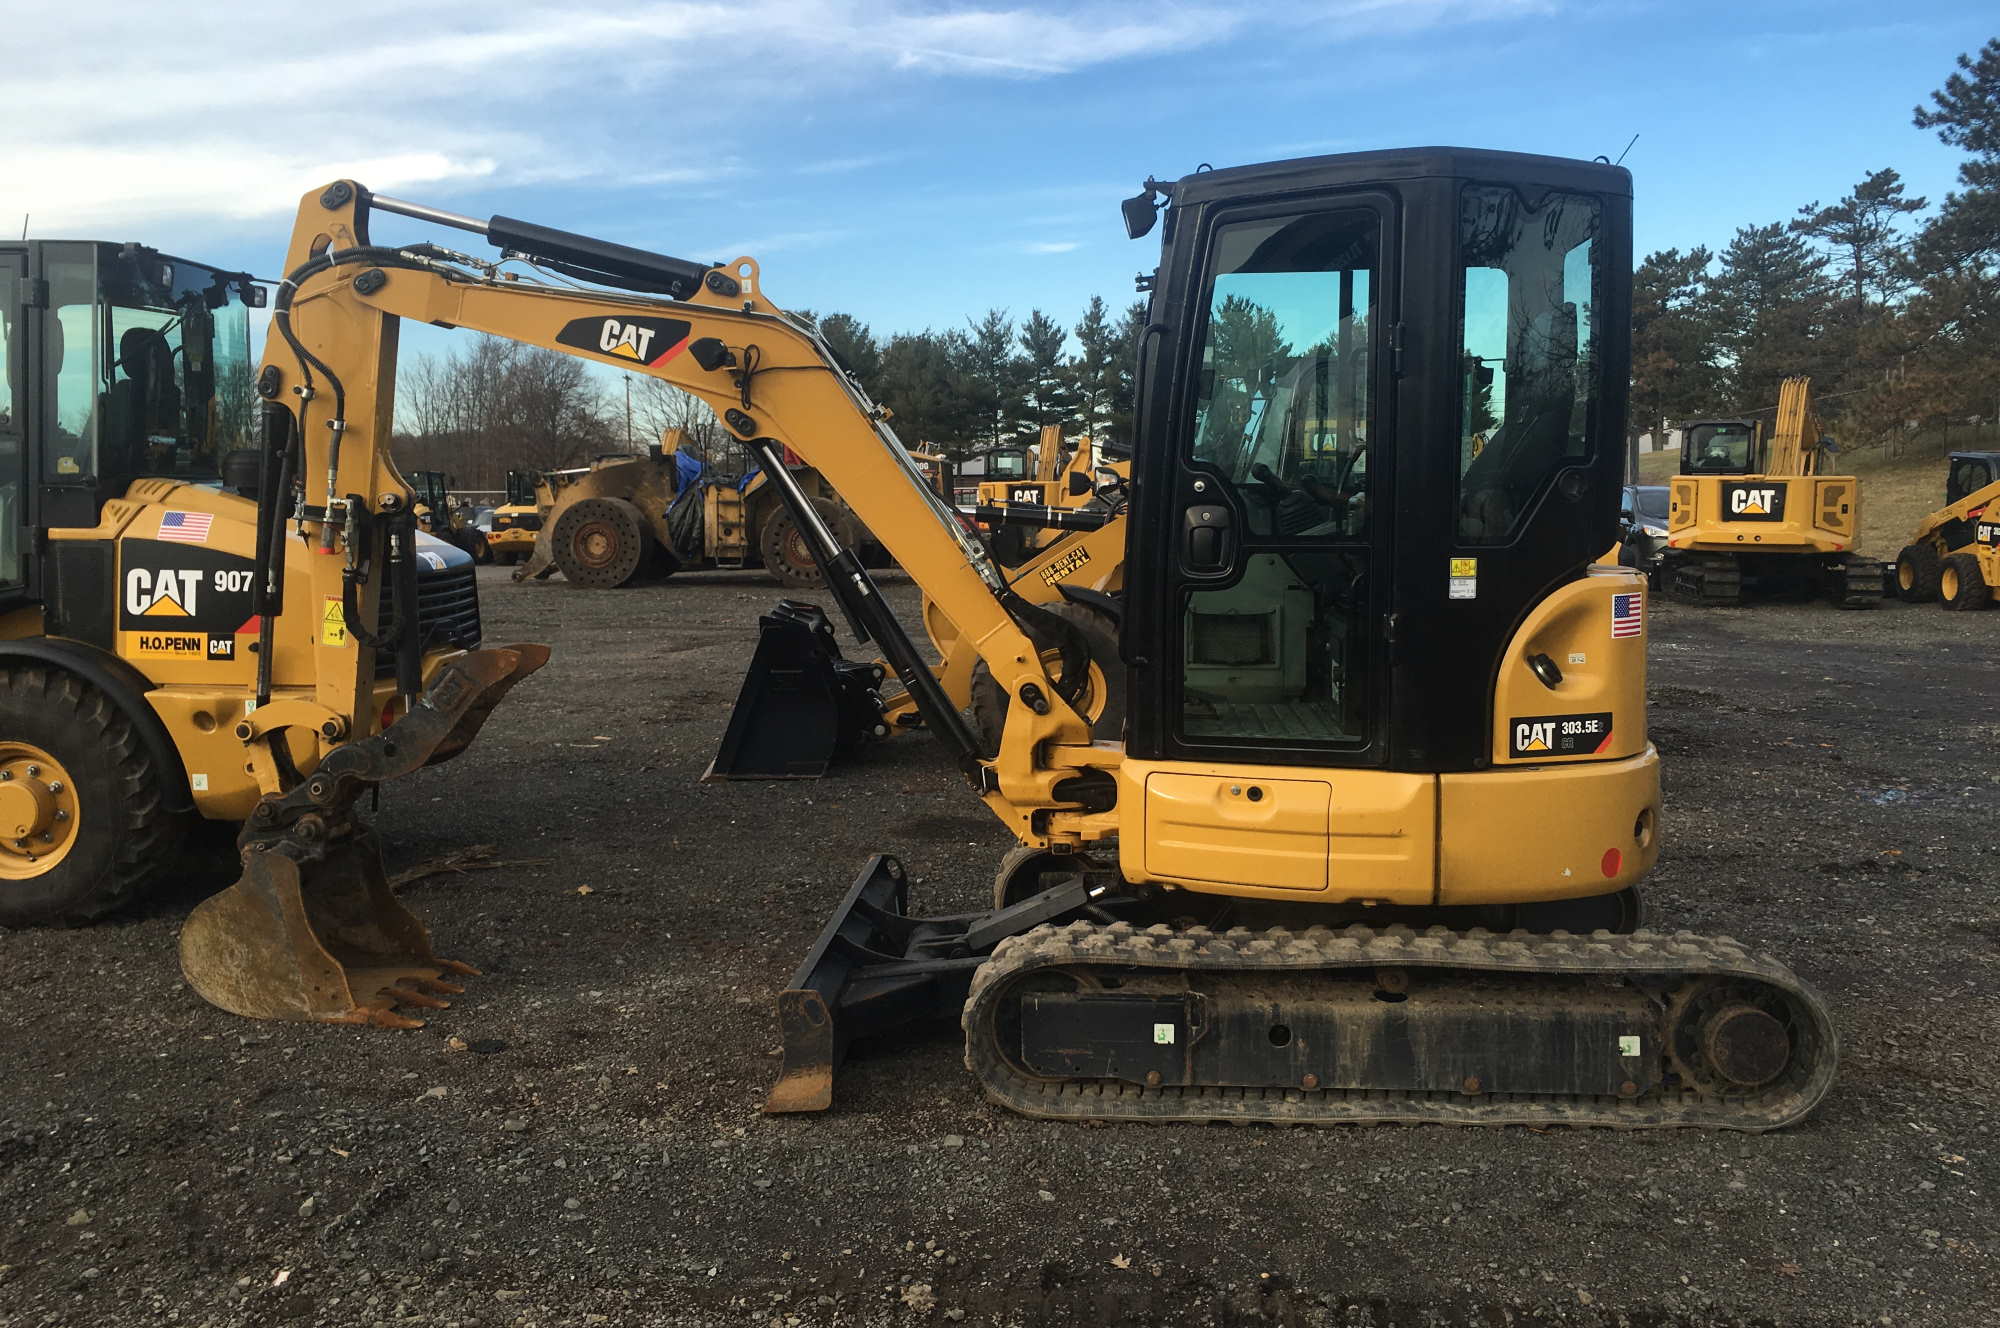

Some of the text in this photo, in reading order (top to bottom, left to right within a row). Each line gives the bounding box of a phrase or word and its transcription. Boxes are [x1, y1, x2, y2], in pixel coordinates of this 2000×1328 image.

[600, 319, 656, 361] CAT
[1014, 490, 1039, 504] CAT
[1731, 489, 1776, 514] CAT
[1977, 525, 1992, 542] CAT
[1045, 556, 1090, 586] RENTAL
[126, 567, 254, 616] CAT 907
[209, 640, 232, 655] CAT
[1516, 722, 1556, 751] CAT
